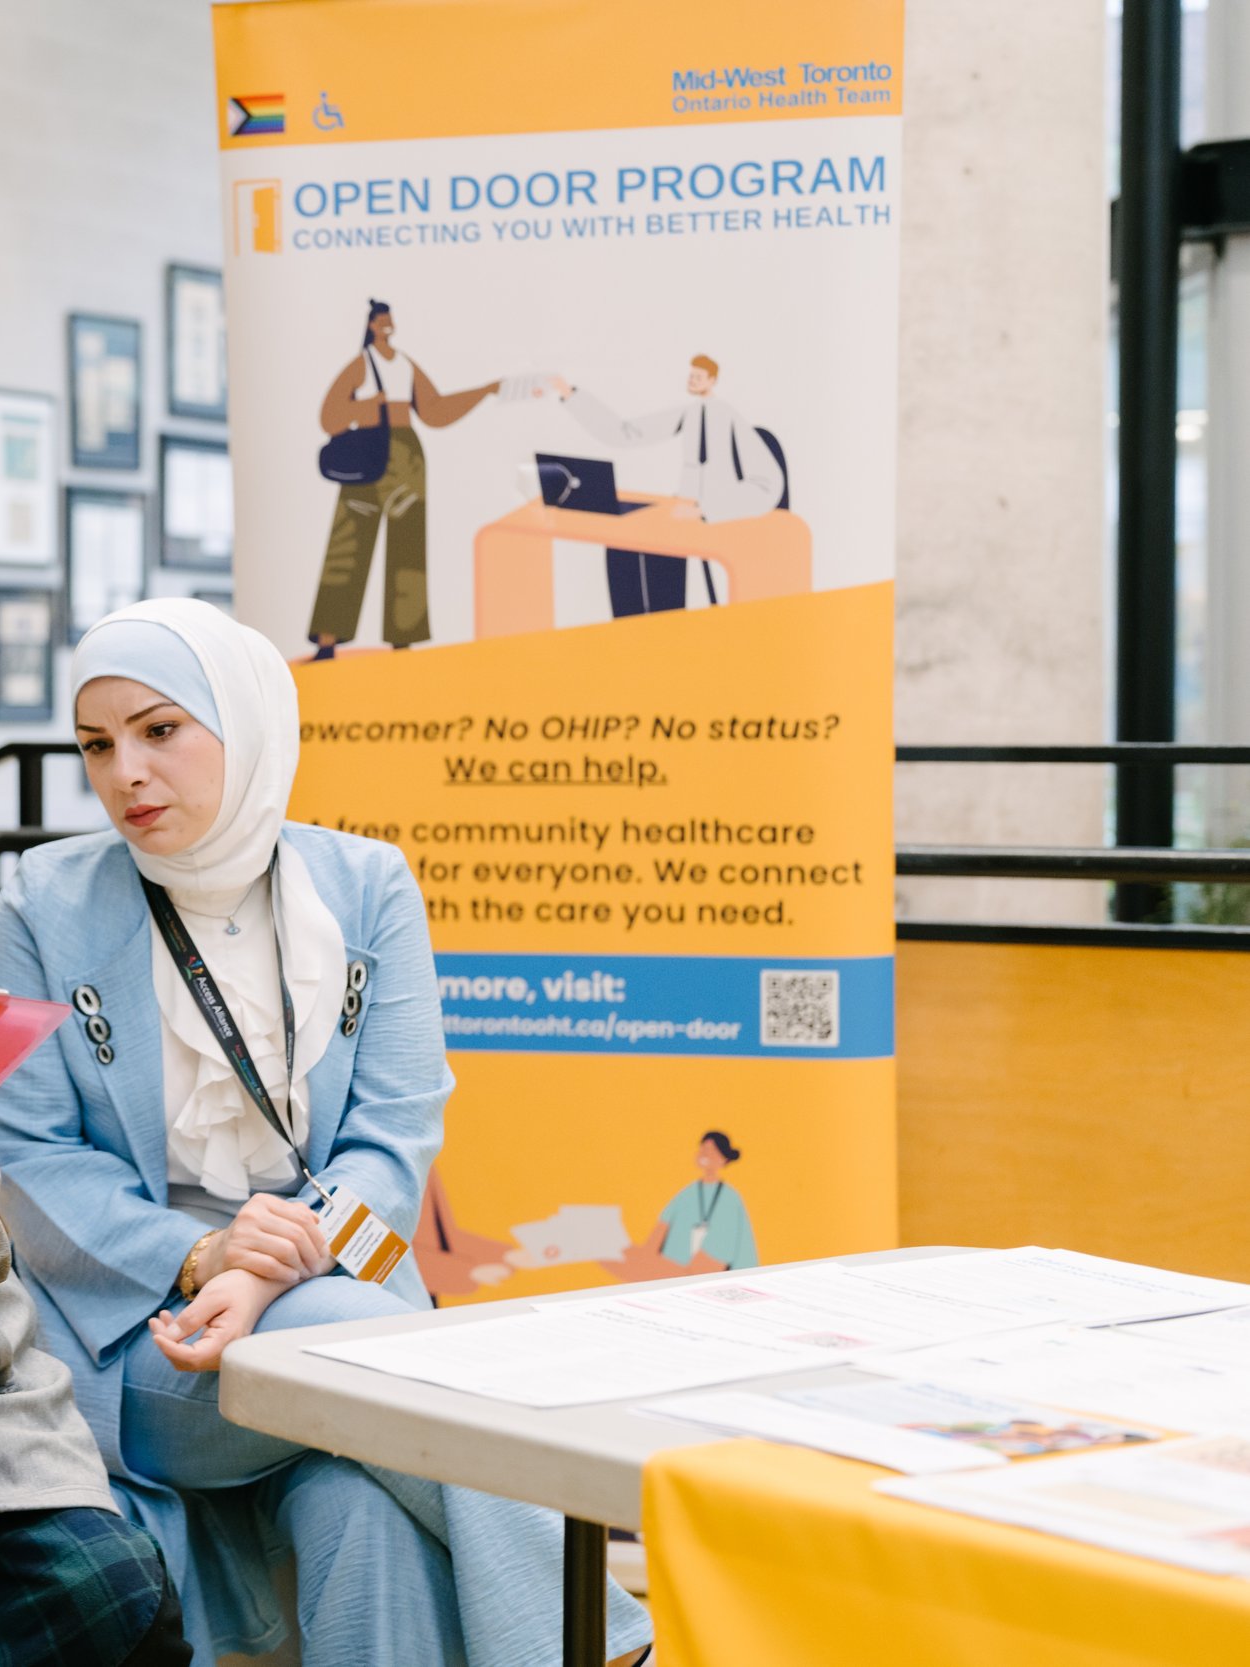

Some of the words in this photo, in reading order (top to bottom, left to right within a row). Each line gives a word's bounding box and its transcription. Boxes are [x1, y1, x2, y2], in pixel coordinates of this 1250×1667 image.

[672, 65, 786, 91] Mid-West
[799, 60, 892, 84] Toronto
[672, 93, 751, 113] Ontario
[758, 89, 827, 109] Health
[835, 86, 891, 105] Team
[293, 177, 430, 218] OPEN
[450, 170, 598, 211] DOOR
[617, 156, 885, 203] PROGRAM
[292, 223, 481, 250] CONNECTING
[492, 219, 552, 242] YOU
[562, 214, 635, 239] WITH
[645, 209, 763, 236] BETTER
[773, 204, 890, 230] HEALTH
[300, 716, 473, 742] ewcomer?
[484, 717, 529, 741] No
[541, 716, 640, 741] OHIP?
[651, 716, 697, 740] No
[708, 714, 840, 740] status?
[444, 756, 497, 784] We
[508, 760, 572, 783] can
[584, 755, 668, 788] help.
[411, 816, 610, 851] community
[622, 818, 815, 845] healthcare
[418, 856, 463, 883] for
[472, 861, 643, 891] everyone.
[654, 859, 708, 884] We
[719, 859, 863, 885] connect
[427, 896, 460, 922] th
[471, 896, 524, 922] the
[535, 901, 612, 923] care
[622, 902, 686, 931] you
[697, 899, 795, 926] need.
[438, 975, 537, 1006] more,
[542, 970, 626, 1003] visit:
[196, 976, 217, 1005] Access
[211, 1005, 234, 1037] Alliance
[442, 1011, 742, 1043] ttorontooht.ca/open-door
